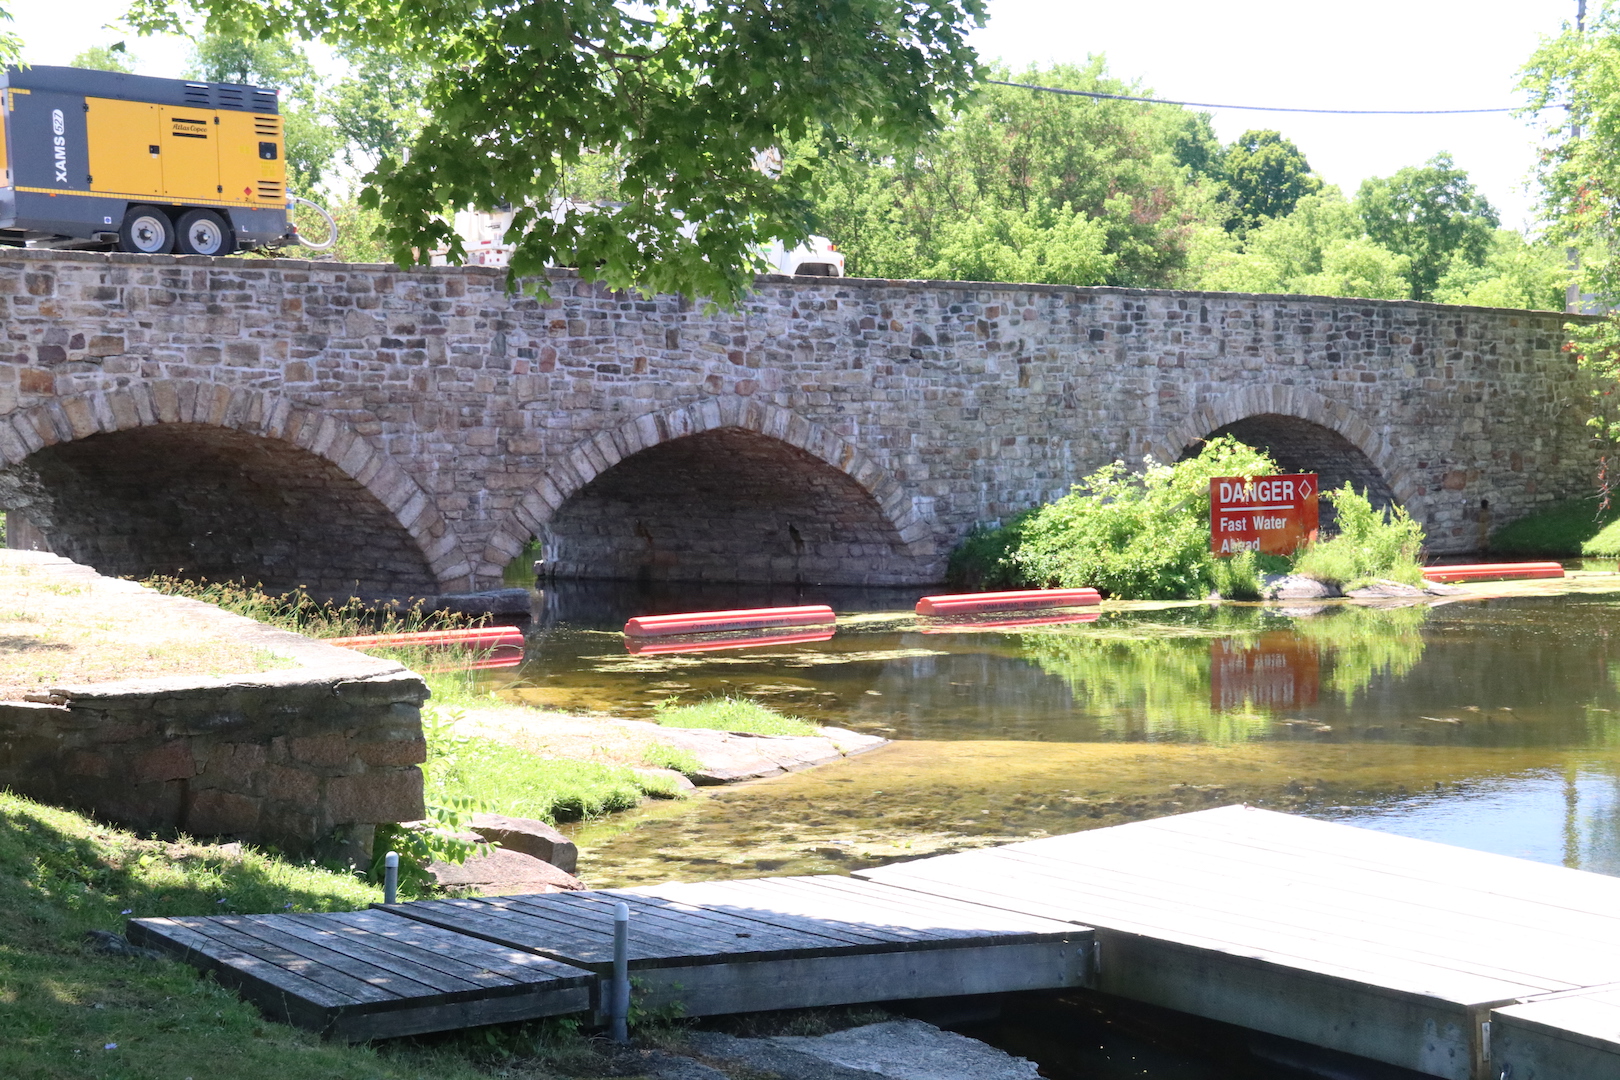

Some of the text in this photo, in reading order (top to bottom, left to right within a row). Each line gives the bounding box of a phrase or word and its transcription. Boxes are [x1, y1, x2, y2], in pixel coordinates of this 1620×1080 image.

[172, 123, 207, 133] Atlas Copco
[53, 111, 67, 183] XAMS 527
[1220, 480, 1294, 503] DANGER
[1220, 515, 1287, 532] Fast Water
